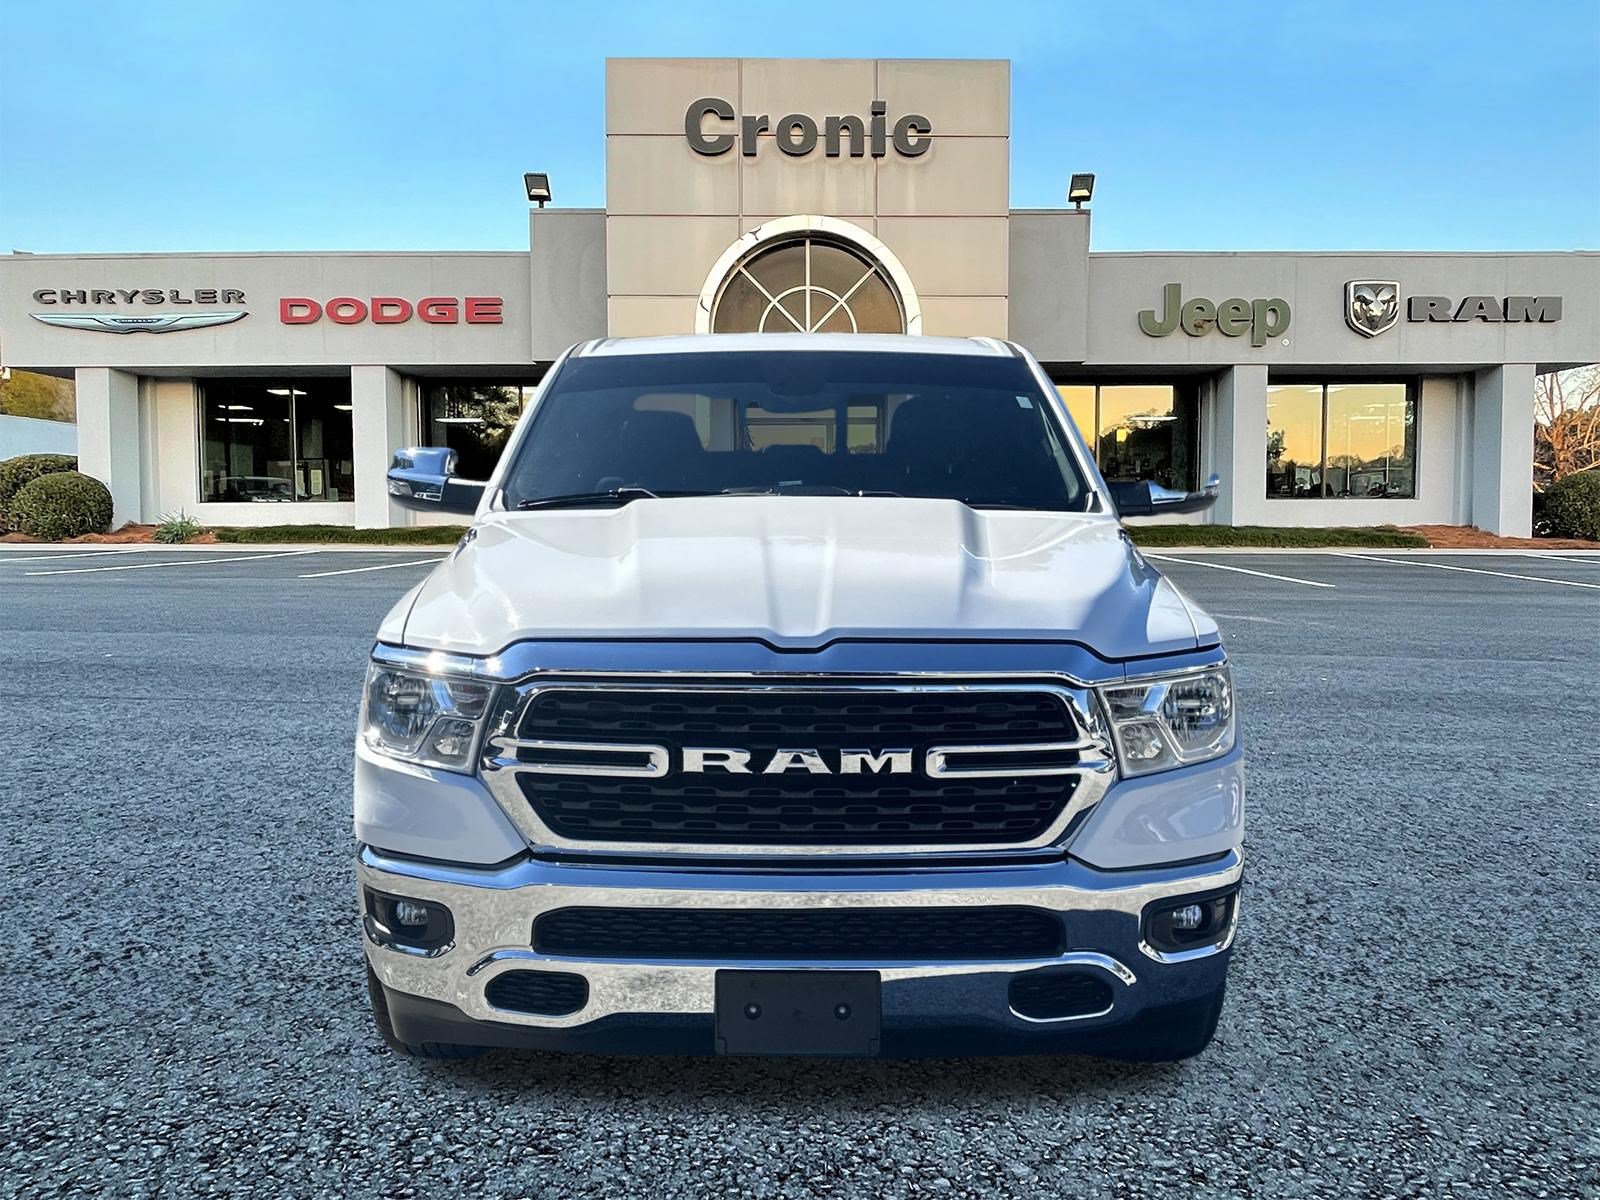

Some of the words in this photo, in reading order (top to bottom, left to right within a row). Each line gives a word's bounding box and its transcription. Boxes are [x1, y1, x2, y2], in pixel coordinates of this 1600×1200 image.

[685, 97, 932, 157] Cronic
[33, 288, 247, 305] CHRYSLER
[279, 296, 504, 325] DODGE
[1408, 296, 1563, 323] RAM
[1138, 283, 1292, 347] Jeep
[682, 746, 913, 774] RAM
